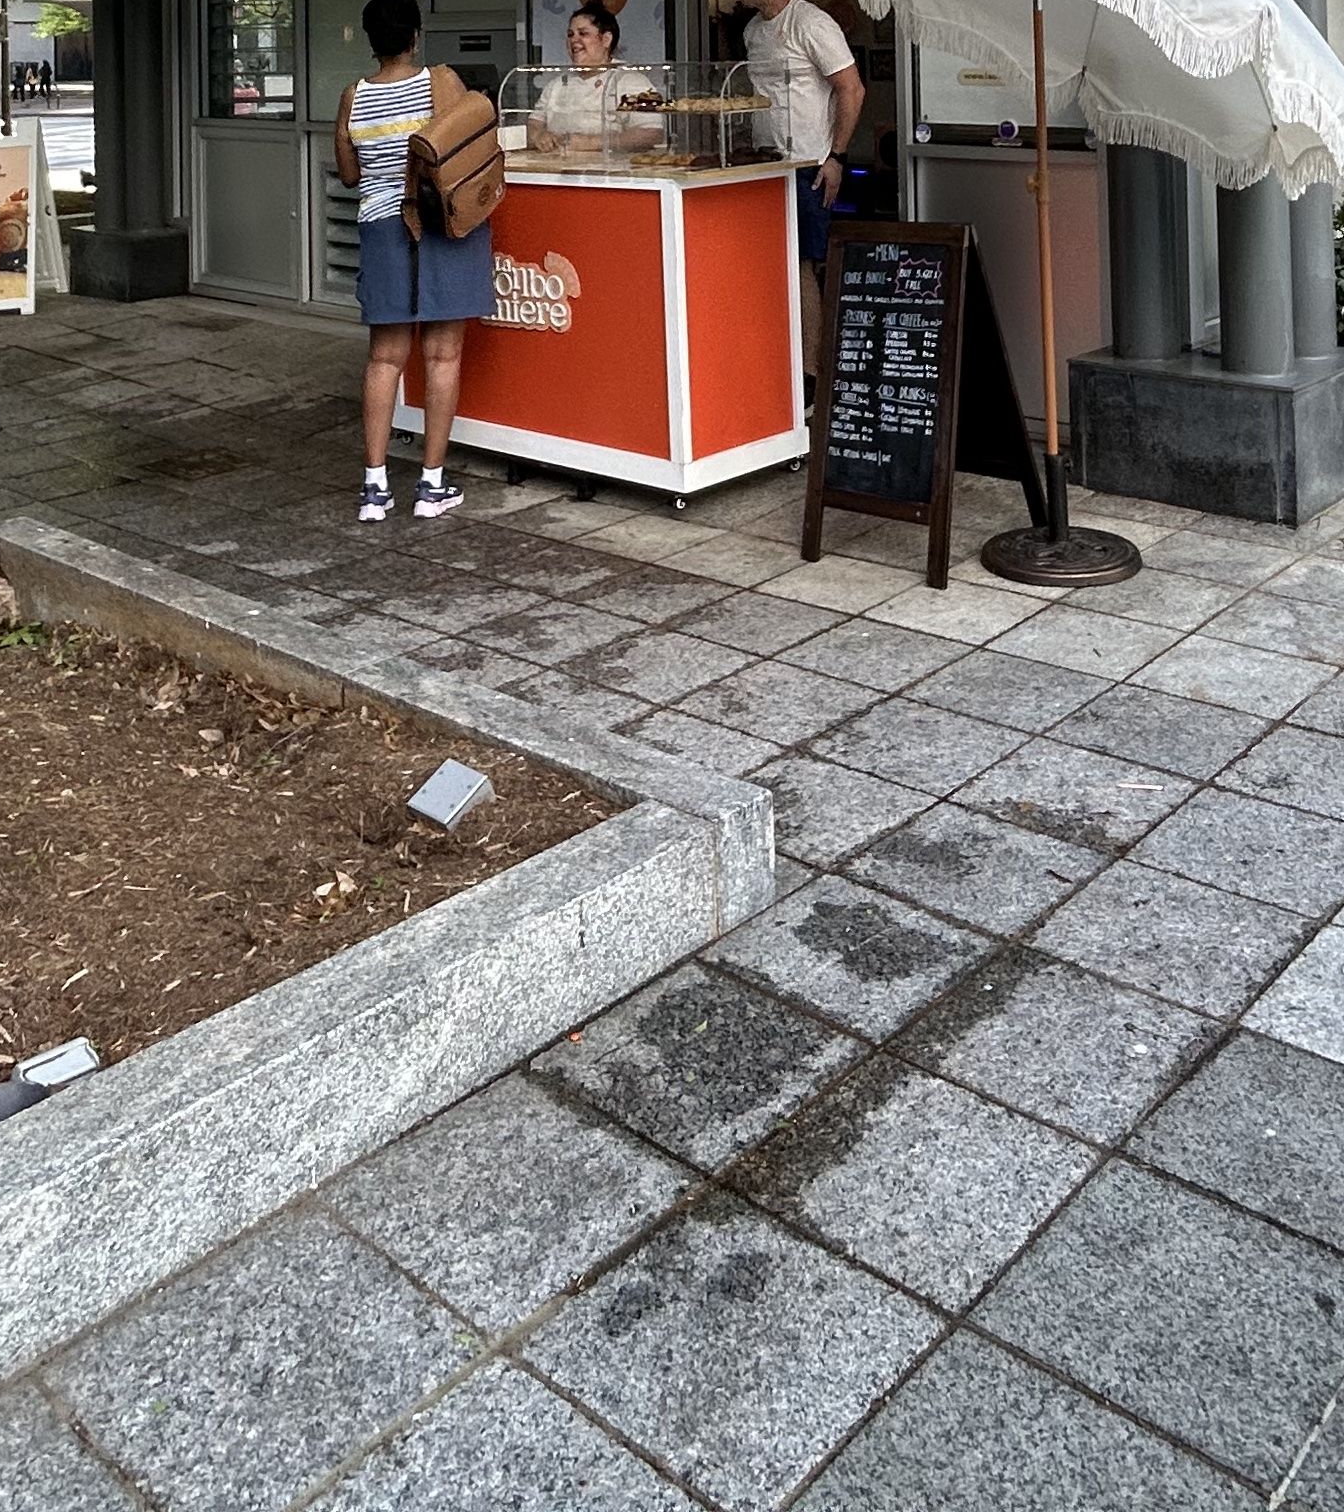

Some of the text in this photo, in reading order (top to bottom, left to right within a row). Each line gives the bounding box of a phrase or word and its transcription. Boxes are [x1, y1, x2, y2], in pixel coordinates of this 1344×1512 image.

[495, 256, 512, 272] La
[493, 267, 564, 300] onbo
[482, 291, 568, 327] niere
